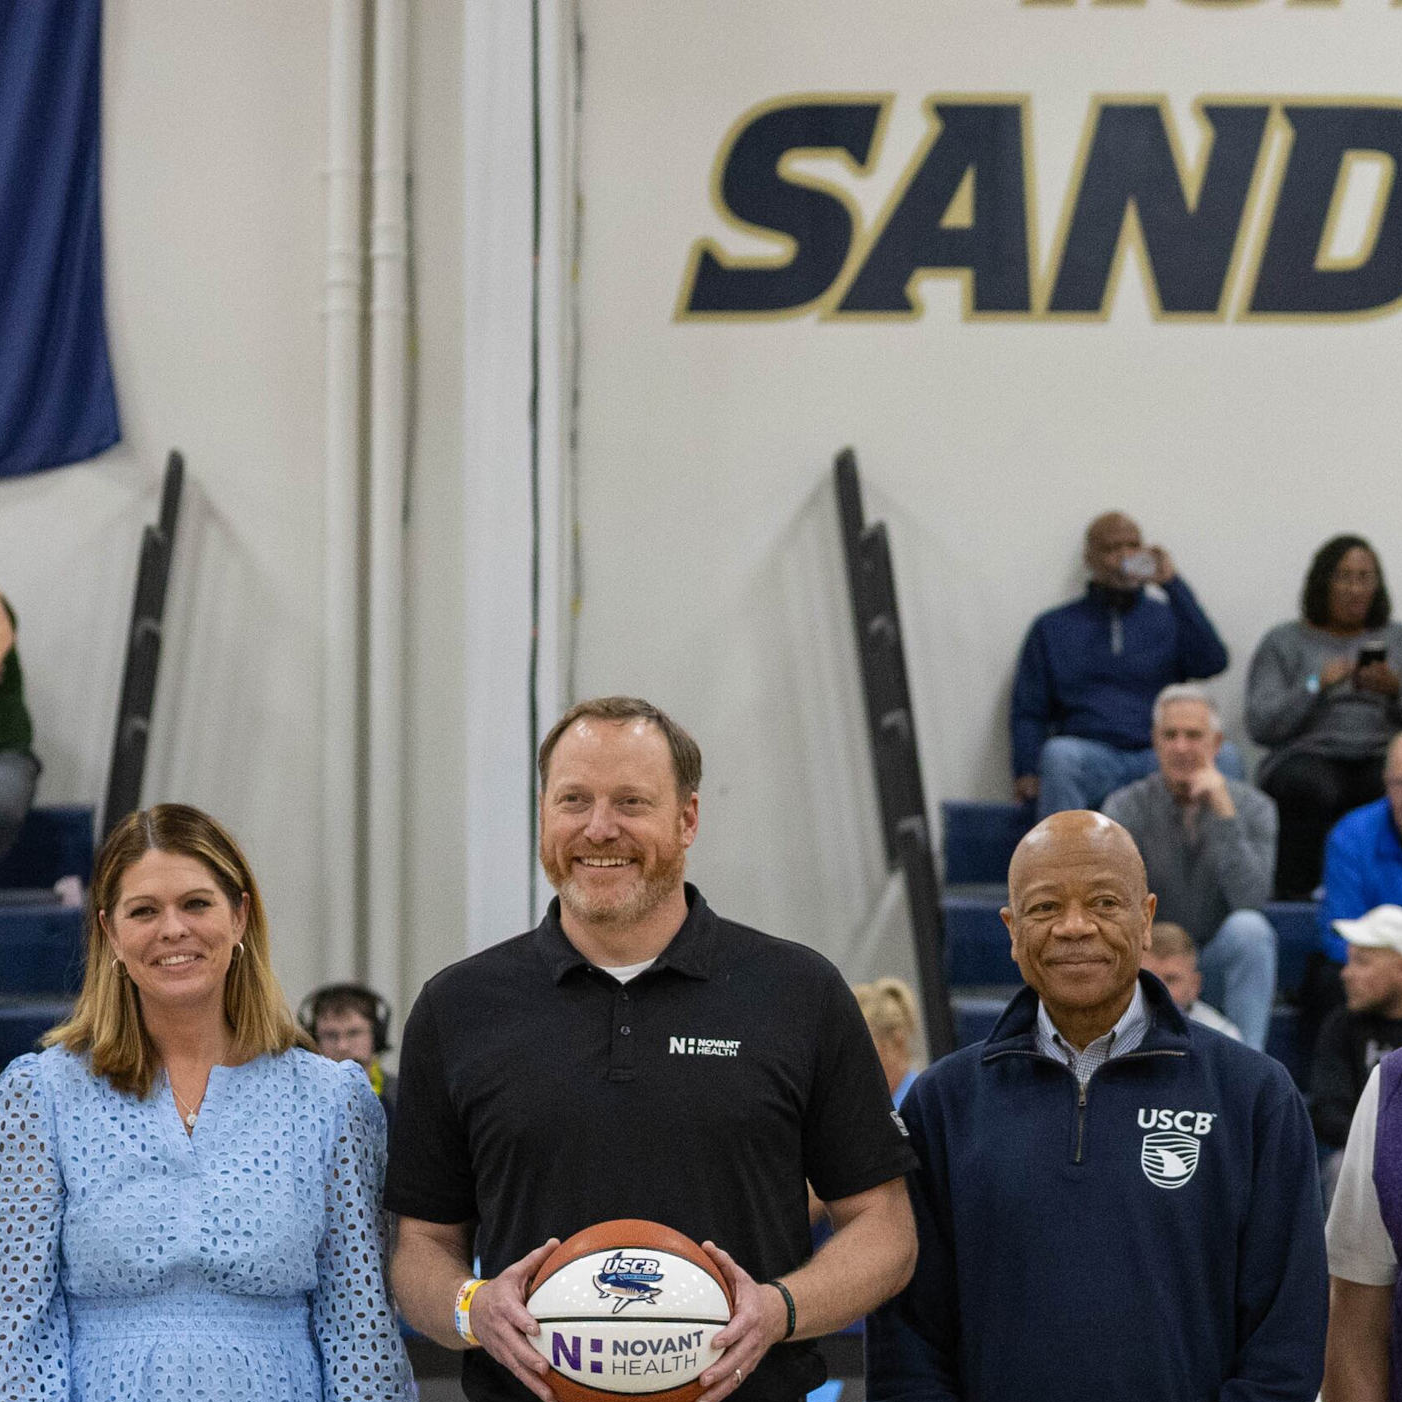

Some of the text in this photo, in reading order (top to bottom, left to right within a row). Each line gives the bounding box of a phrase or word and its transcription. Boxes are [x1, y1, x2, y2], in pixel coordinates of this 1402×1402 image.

[696, 1046, 738, 1057] HEALTH
[698, 1038, 742, 1049] NOVANT
[1137, 1108, 1213, 1135] USCB
[603, 1258, 659, 1275] USCB
[612, 1330, 704, 1356] NOVANT
[612, 1352, 697, 1376] HEALTH
